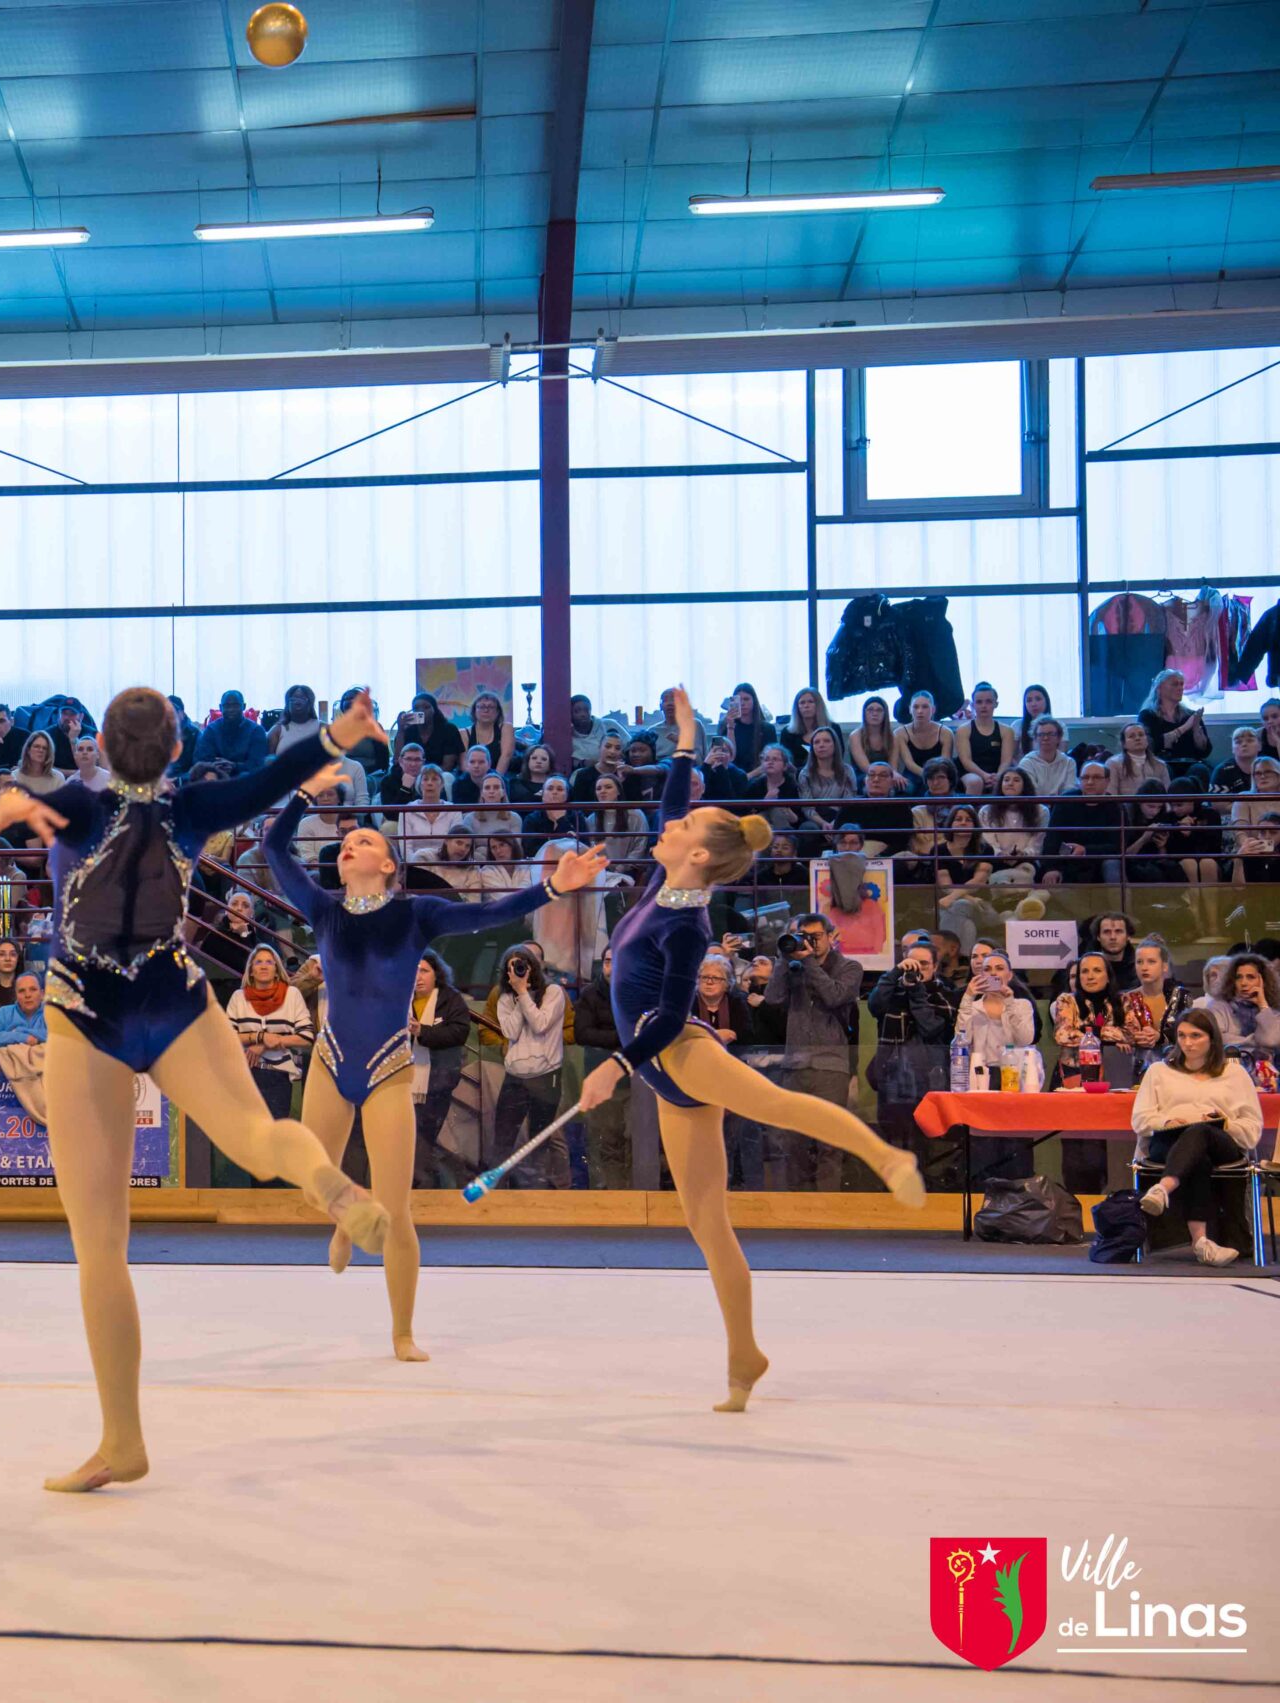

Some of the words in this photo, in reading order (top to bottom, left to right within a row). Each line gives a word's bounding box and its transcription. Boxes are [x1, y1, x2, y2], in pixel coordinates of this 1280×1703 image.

[1024, 929, 1060, 938] SORTIE
[0, 1155, 11, 1169] &
[39, 1177, 54, 1186] DE
